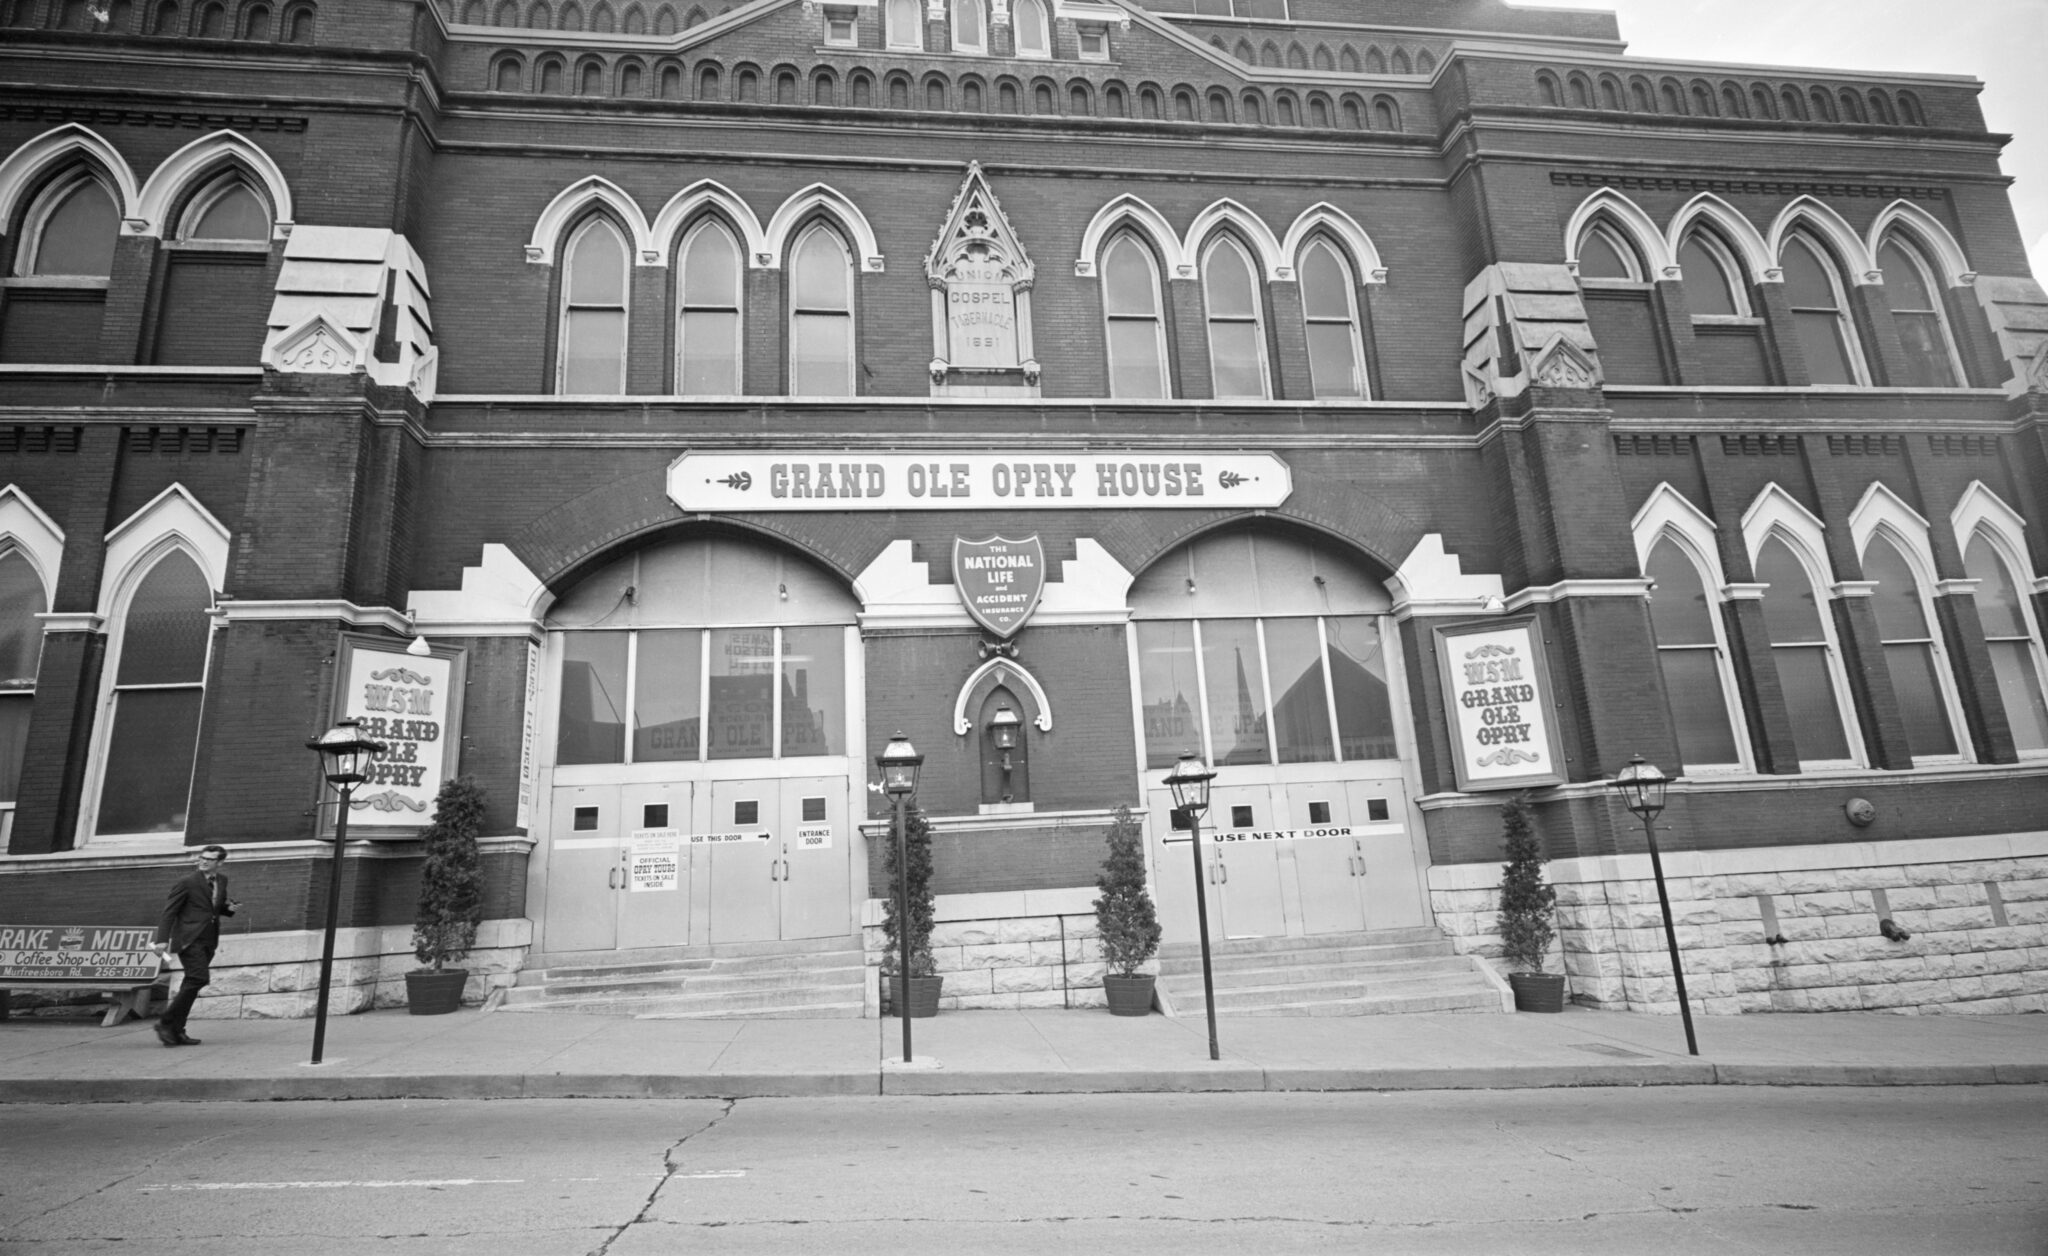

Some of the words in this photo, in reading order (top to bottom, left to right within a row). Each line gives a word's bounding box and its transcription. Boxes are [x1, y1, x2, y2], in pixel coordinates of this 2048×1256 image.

[951, 292, 1010, 304] GOSPEL
[769, 462, 887, 499] GRAND
[906, 463, 971, 499] OLE
[991, 463, 1077, 498] OPRY
[1097, 462, 1204, 497] HOUSE
[989, 545, 1007, 553] THE
[964, 554, 1034, 569] NATIONAL
[987, 570, 1014, 583] LIFE
[976, 594, 1028, 604] ACCIDENT
[1463, 657, 1524, 685] WSM
[364, 684, 434, 716] WSM
[1461, 684, 1534, 708] GRAND
[1481, 705, 1520, 726] OLE
[726, 723, 761, 746] OLE
[780, 722, 818, 744] PRY
[1476, 723, 1531, 745] OPRY
[374, 741, 418, 763] OLE
[707, 834, 722, 842] THIS
[798, 829, 830, 838] ENTRANCE
[805, 837, 823, 845] DOOR
[1214, 832, 1247, 842] USE
[1252, 830, 1297, 840] NEXT
[1303, 828, 1351, 838] DOOR
[634, 864, 653, 875] OPRY
[654, 863, 676, 873] TOURS
[0, 929, 53, 950] RAKE
[91, 930, 154, 951] MOTEL
[15, 951, 53, 965] Coffee
[56, 952, 84, 967] Shop
[90, 952, 123, 966] Color
[3, 967, 63, 977] Murfreesboro
[69, 967, 83, 977] Rd.
[95, 967, 147, 977] 256-8177
